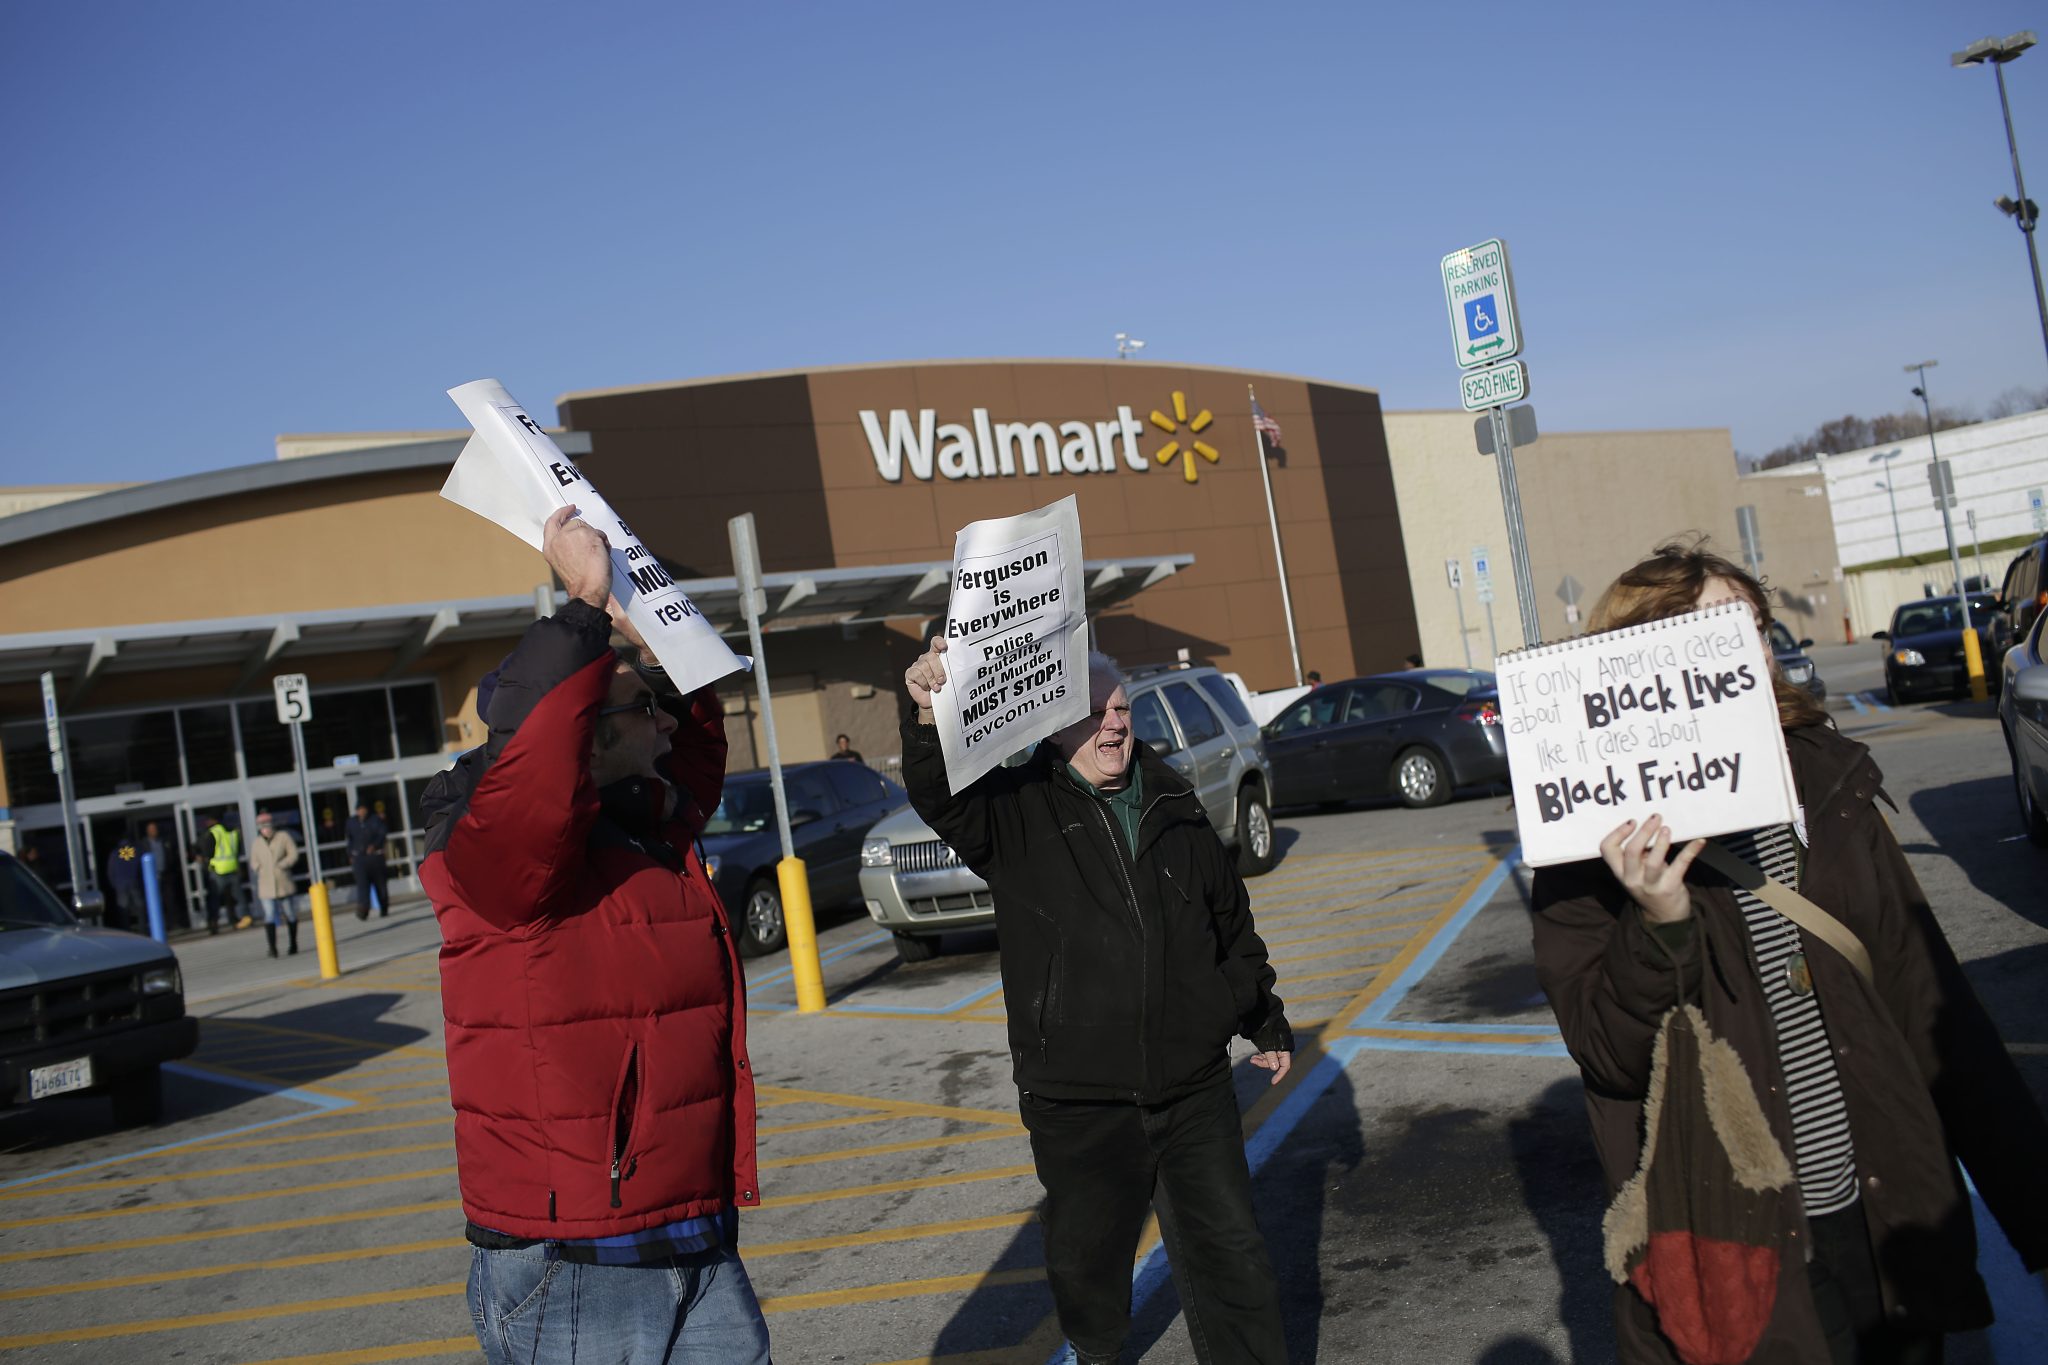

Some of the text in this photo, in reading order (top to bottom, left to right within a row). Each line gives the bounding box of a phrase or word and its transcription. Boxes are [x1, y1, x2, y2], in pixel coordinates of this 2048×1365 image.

[1447, 251, 1499, 281] RESERVED
[1454, 272, 1499, 299] PARKING
[1466, 370, 1518, 401] $250 FINE
[859, 405, 1149, 482] Walmart
[956, 550, 1048, 591] Ferguson
[948, 588, 1060, 639] Everywhere
[993, 588, 1011, 607] is
[977, 642, 1042, 680] Brutality
[983, 631, 1034, 661] Police
[1507, 622, 1745, 705] If only America cared
[962, 659, 1063, 728] MUST STOP!
[969, 650, 1053, 700] and Murder
[1510, 664, 1756, 735] about Black Lives
[286, 690, 303, 719] 5
[965, 685, 1066, 749] revcom.us
[1536, 713, 1702, 772] like it cares about
[1535, 752, 1741, 823] Black Friday
